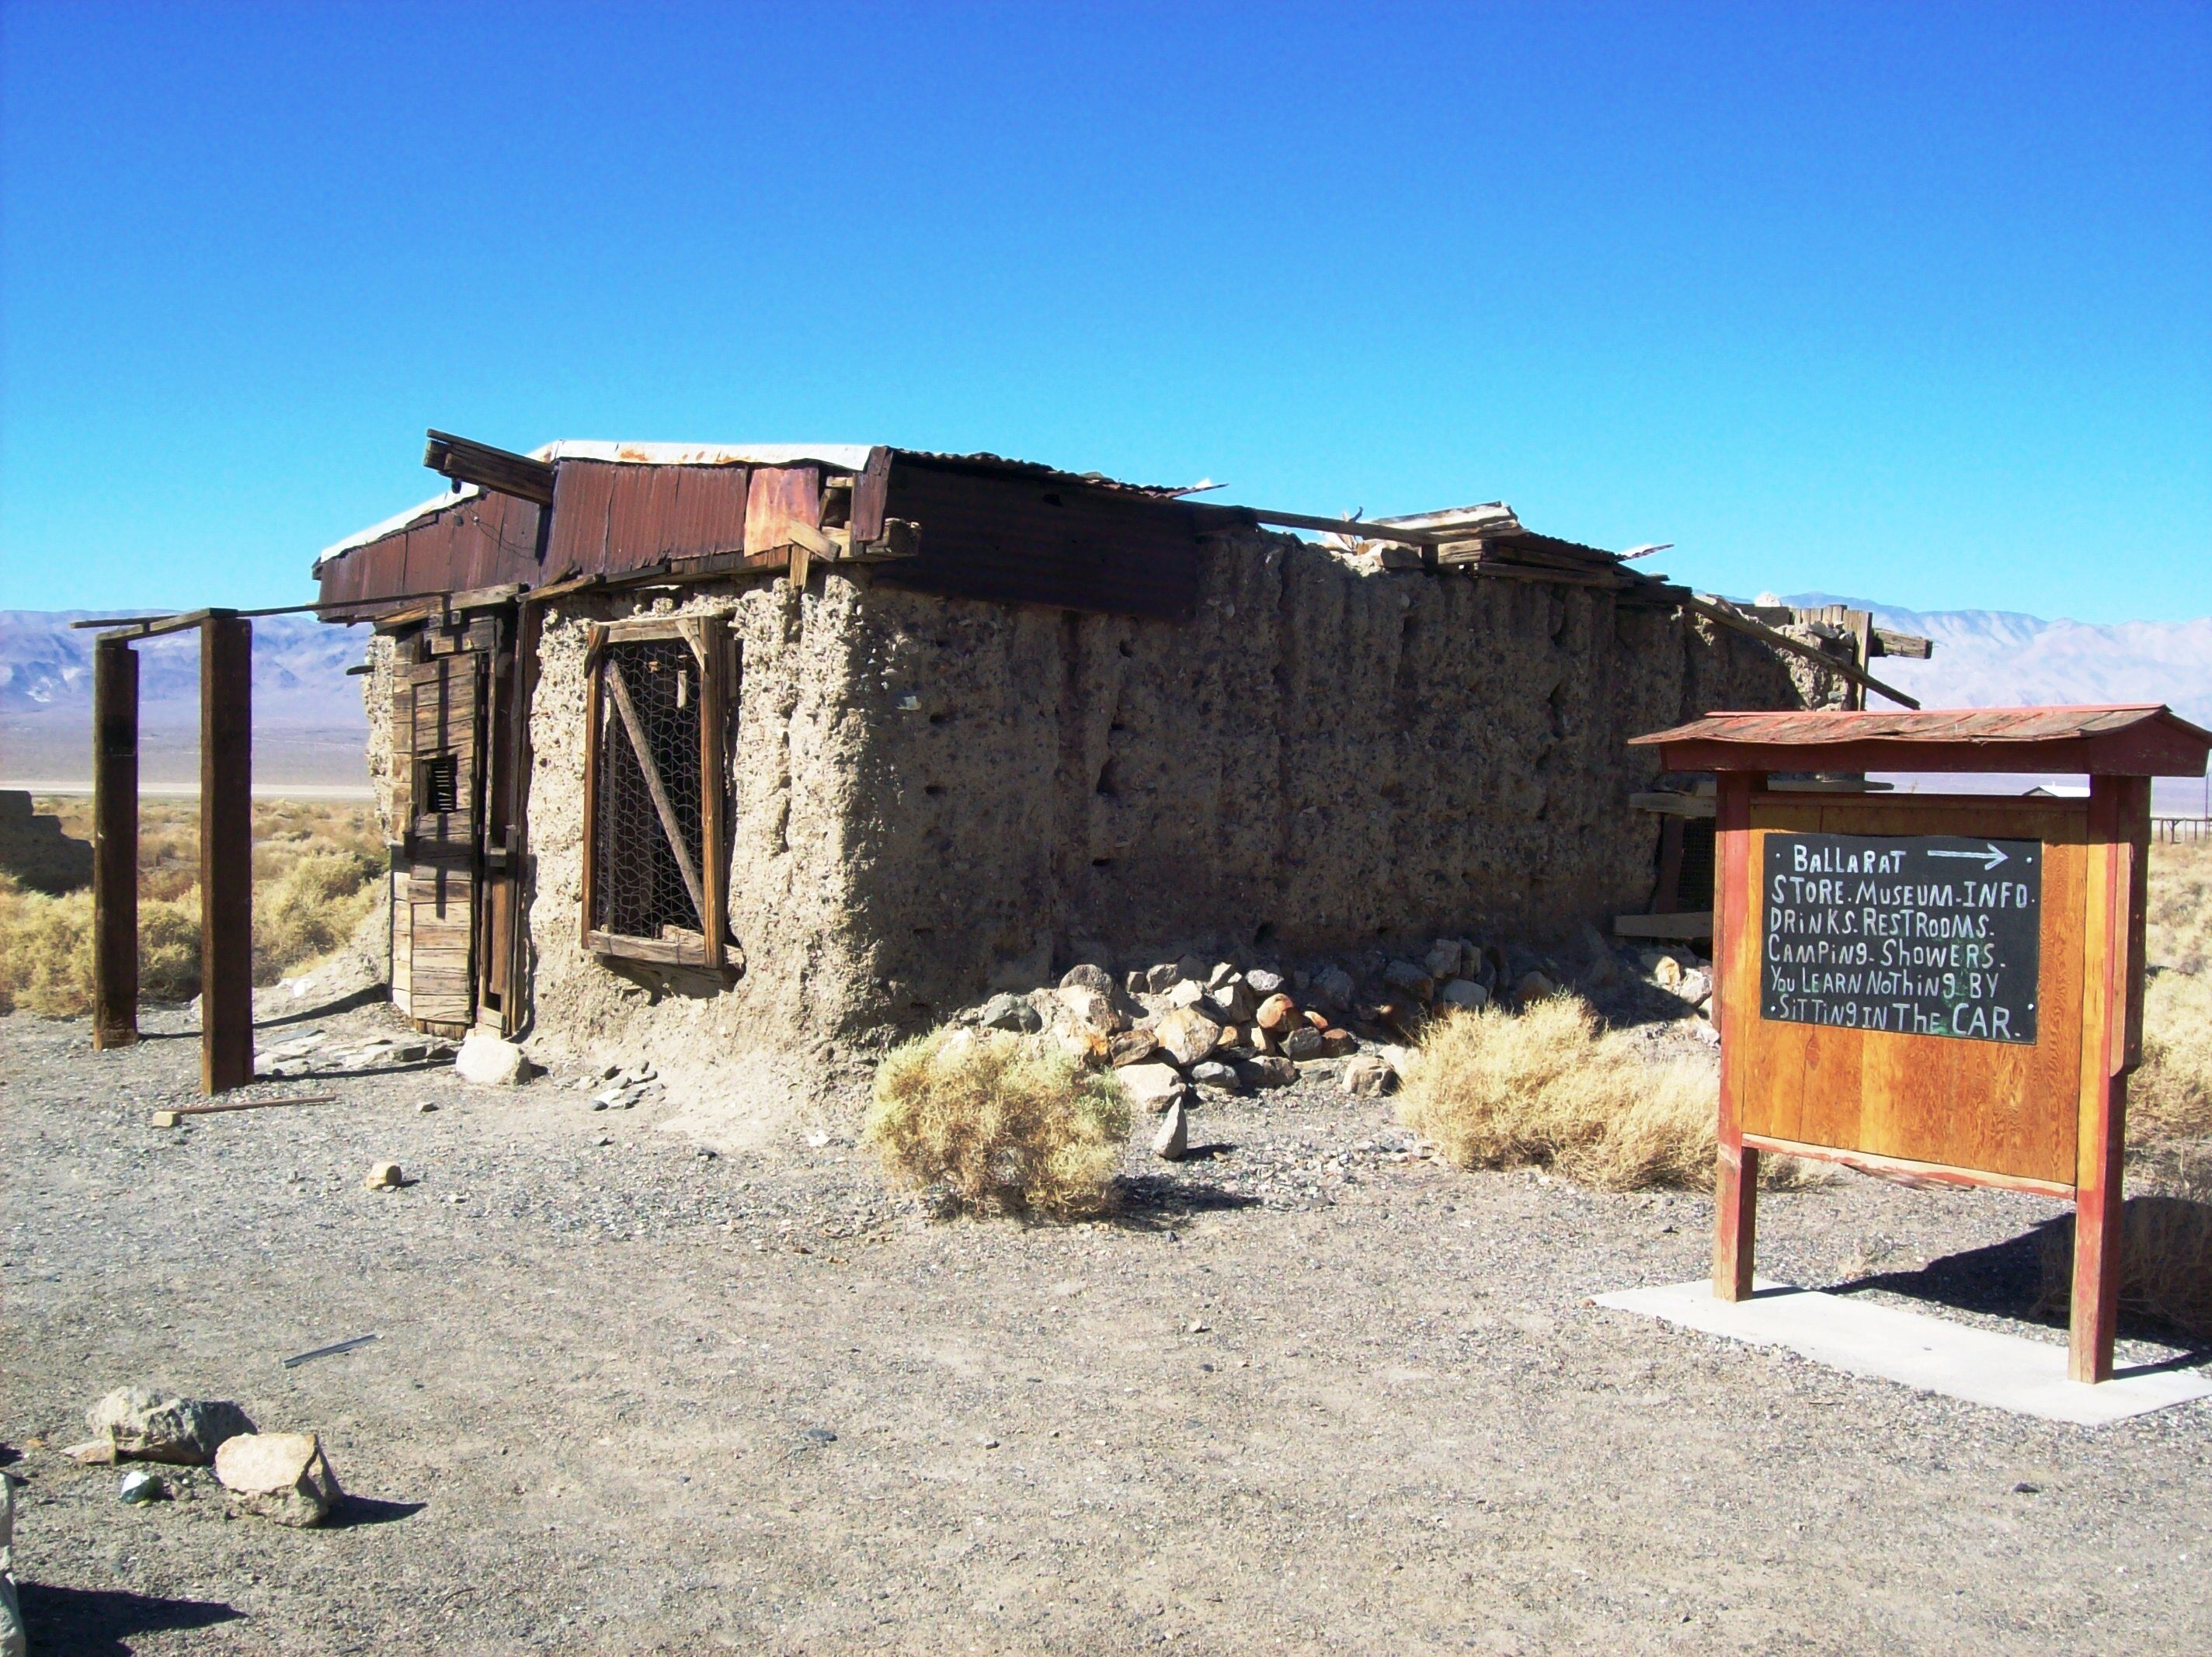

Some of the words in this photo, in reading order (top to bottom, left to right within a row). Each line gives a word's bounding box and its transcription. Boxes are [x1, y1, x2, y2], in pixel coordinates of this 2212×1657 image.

[1802, 967, 1862, 993] LEARN
[1970, 972, 1999, 999] BY
[1862, 1006, 1887, 1030] IN
